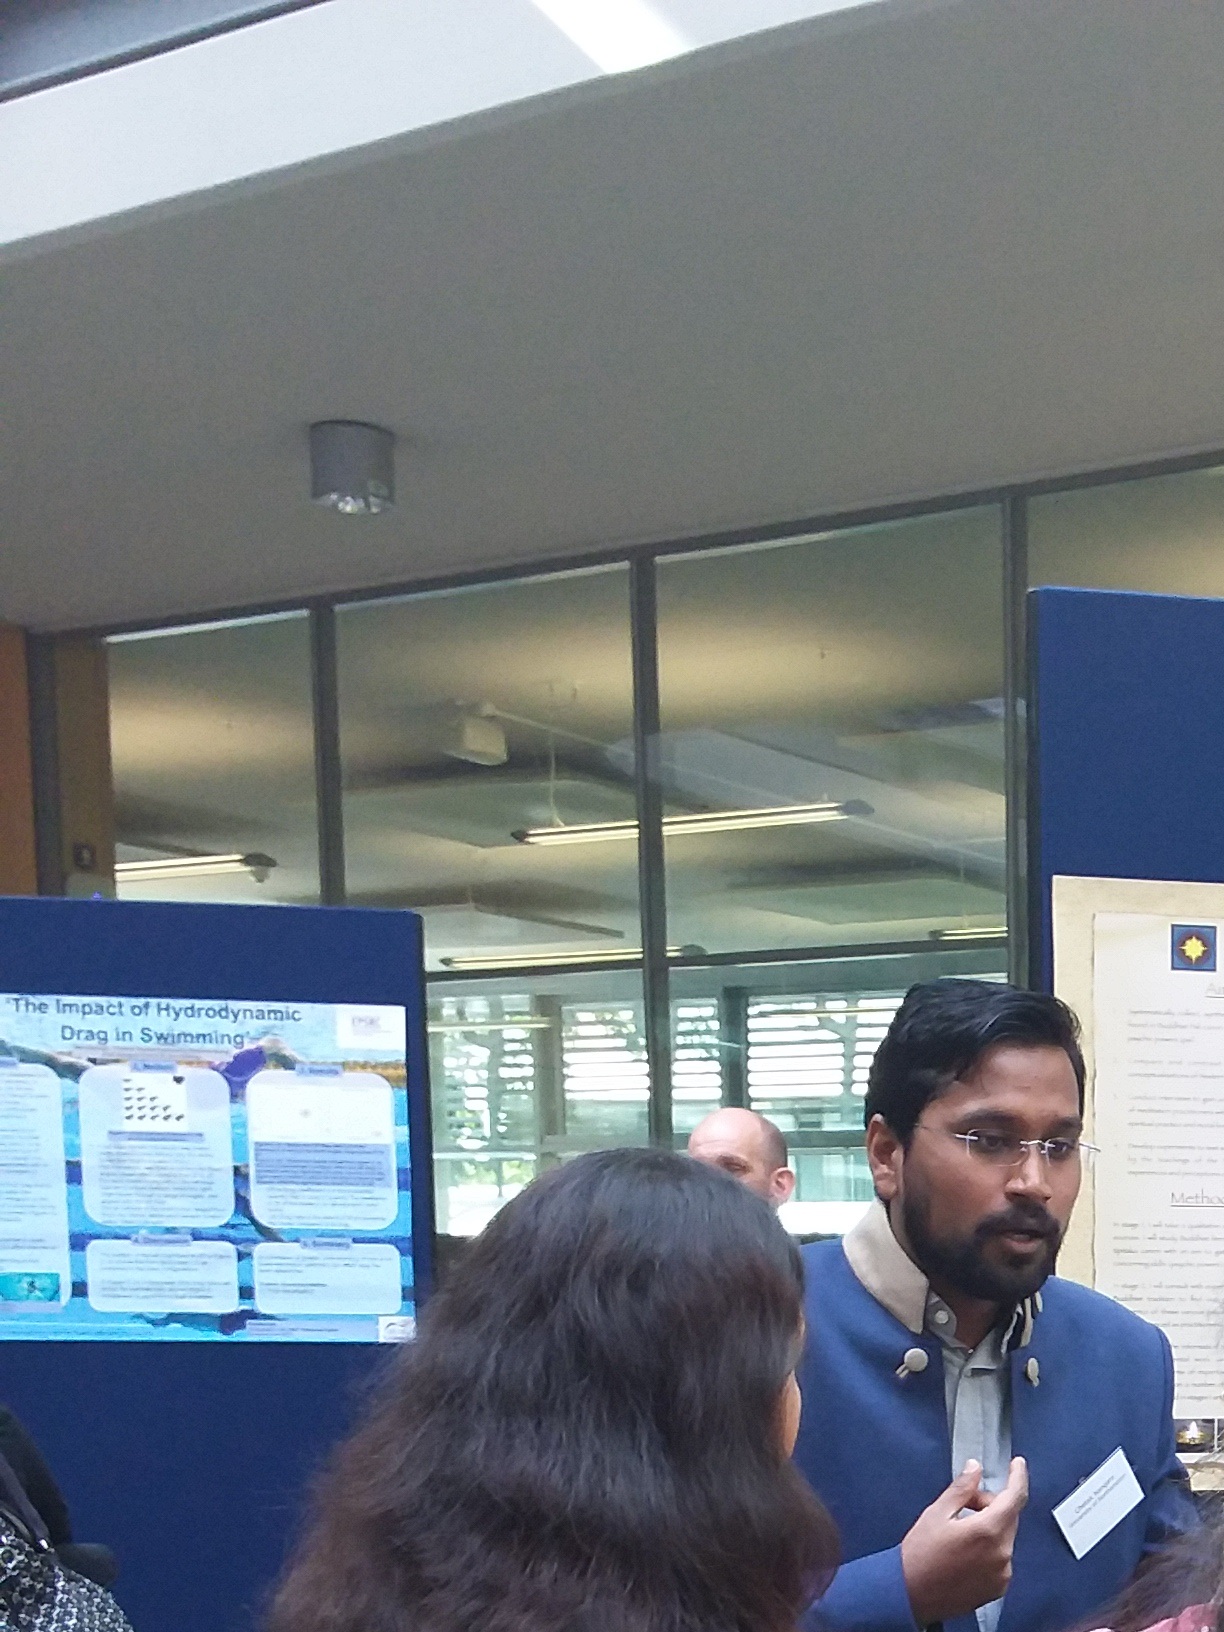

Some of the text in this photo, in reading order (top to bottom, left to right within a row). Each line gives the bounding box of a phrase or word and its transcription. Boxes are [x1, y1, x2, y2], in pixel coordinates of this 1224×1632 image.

[56, 1000, 124, 1018] Impact
[130, 1002, 150, 1016] of
[157, 1002, 301, 1022] Hydrodynamic
[61, 1025, 108, 1043] Drag
[115, 1027, 133, 1041] in
